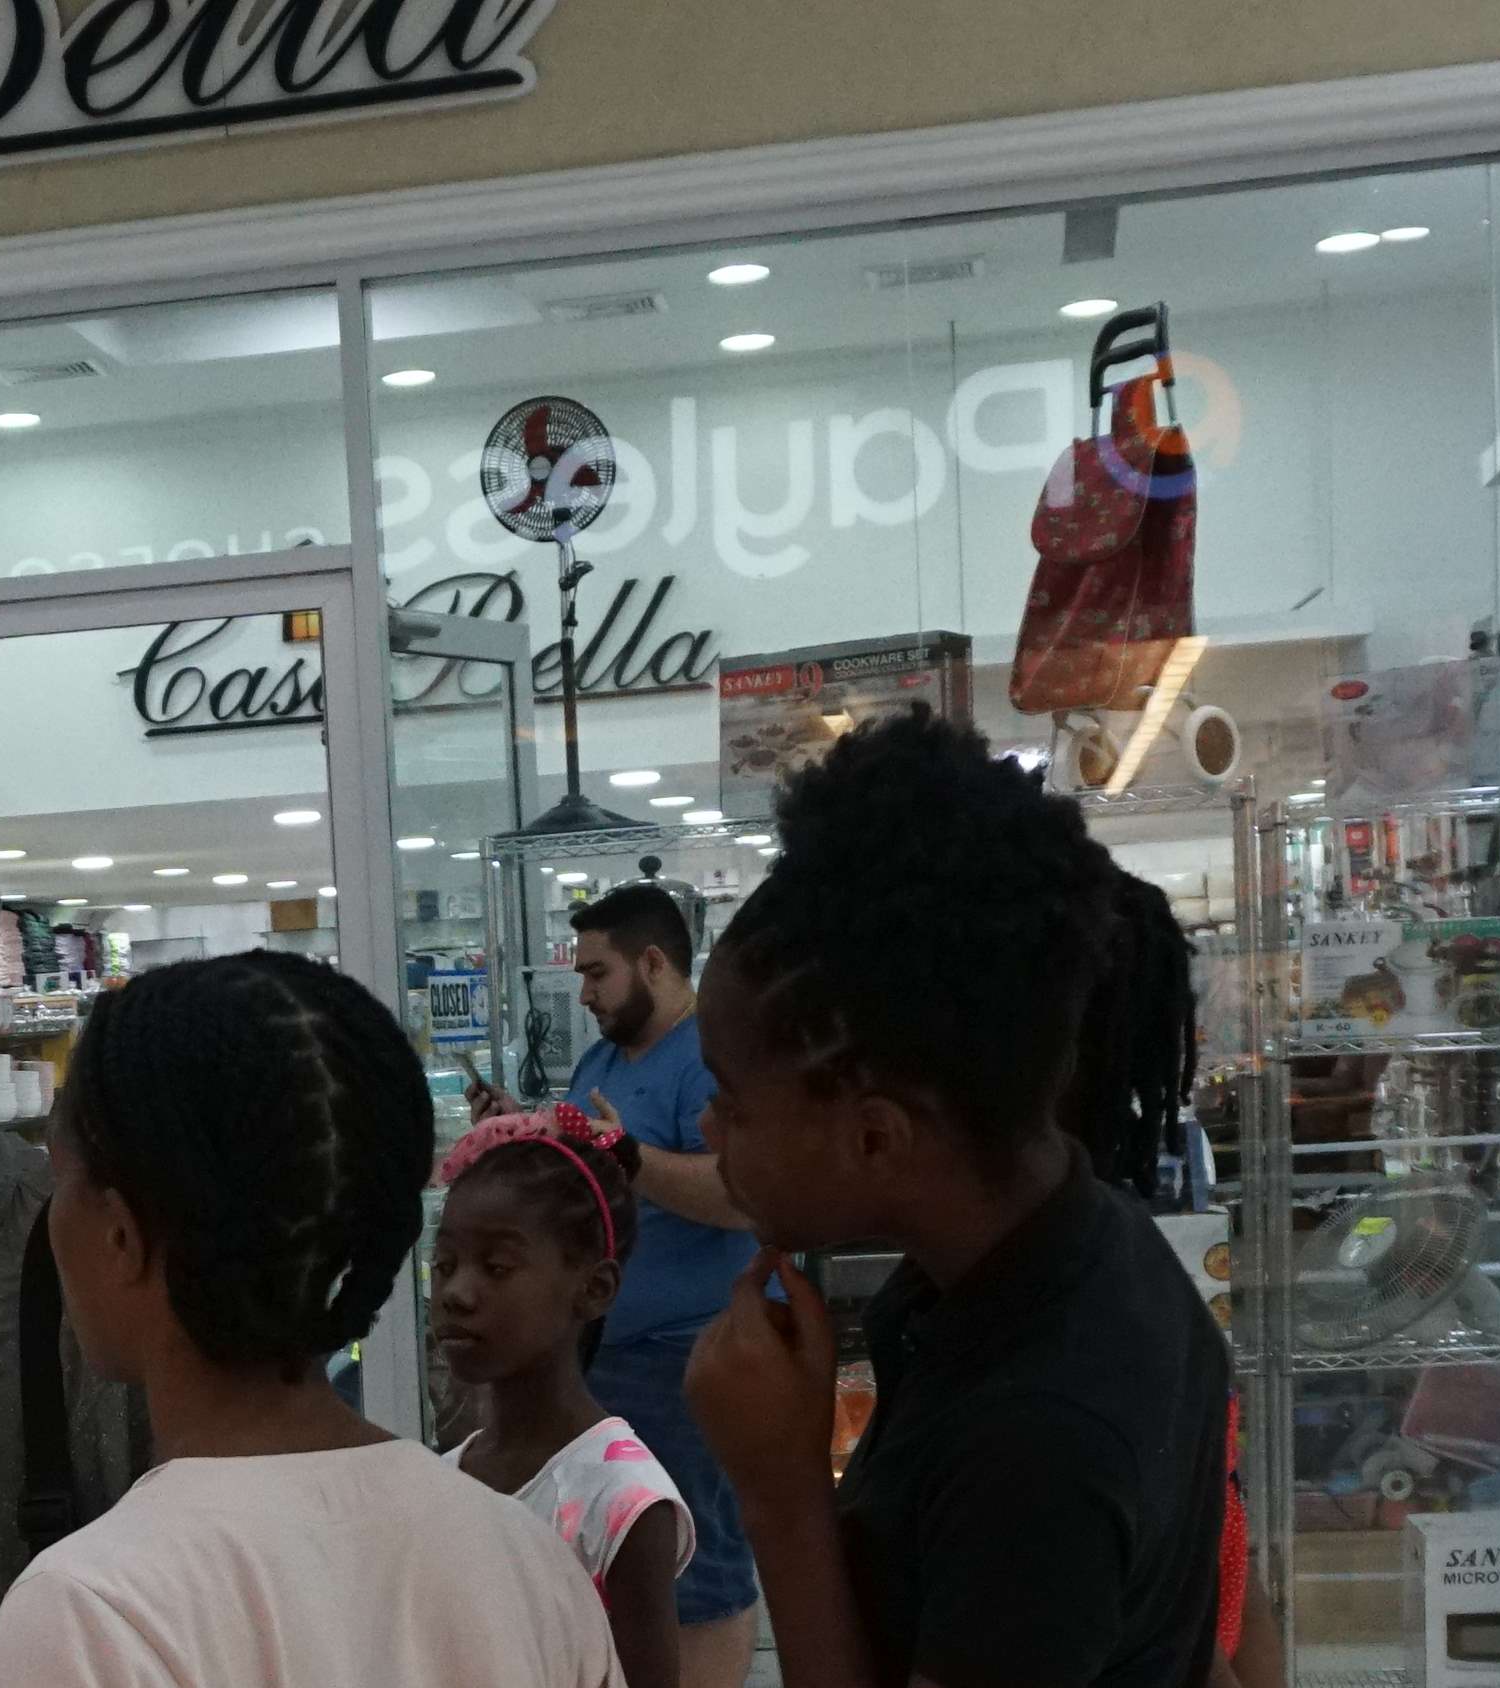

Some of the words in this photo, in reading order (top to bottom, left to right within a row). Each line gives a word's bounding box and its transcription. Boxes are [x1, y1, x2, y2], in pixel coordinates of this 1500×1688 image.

[833, 651, 902, 670] COOKWARE
[905, 647, 930, 661] SET
[1310, 929, 1383, 948] SANKEY
[430, 983, 470, 1018] CLOSED
